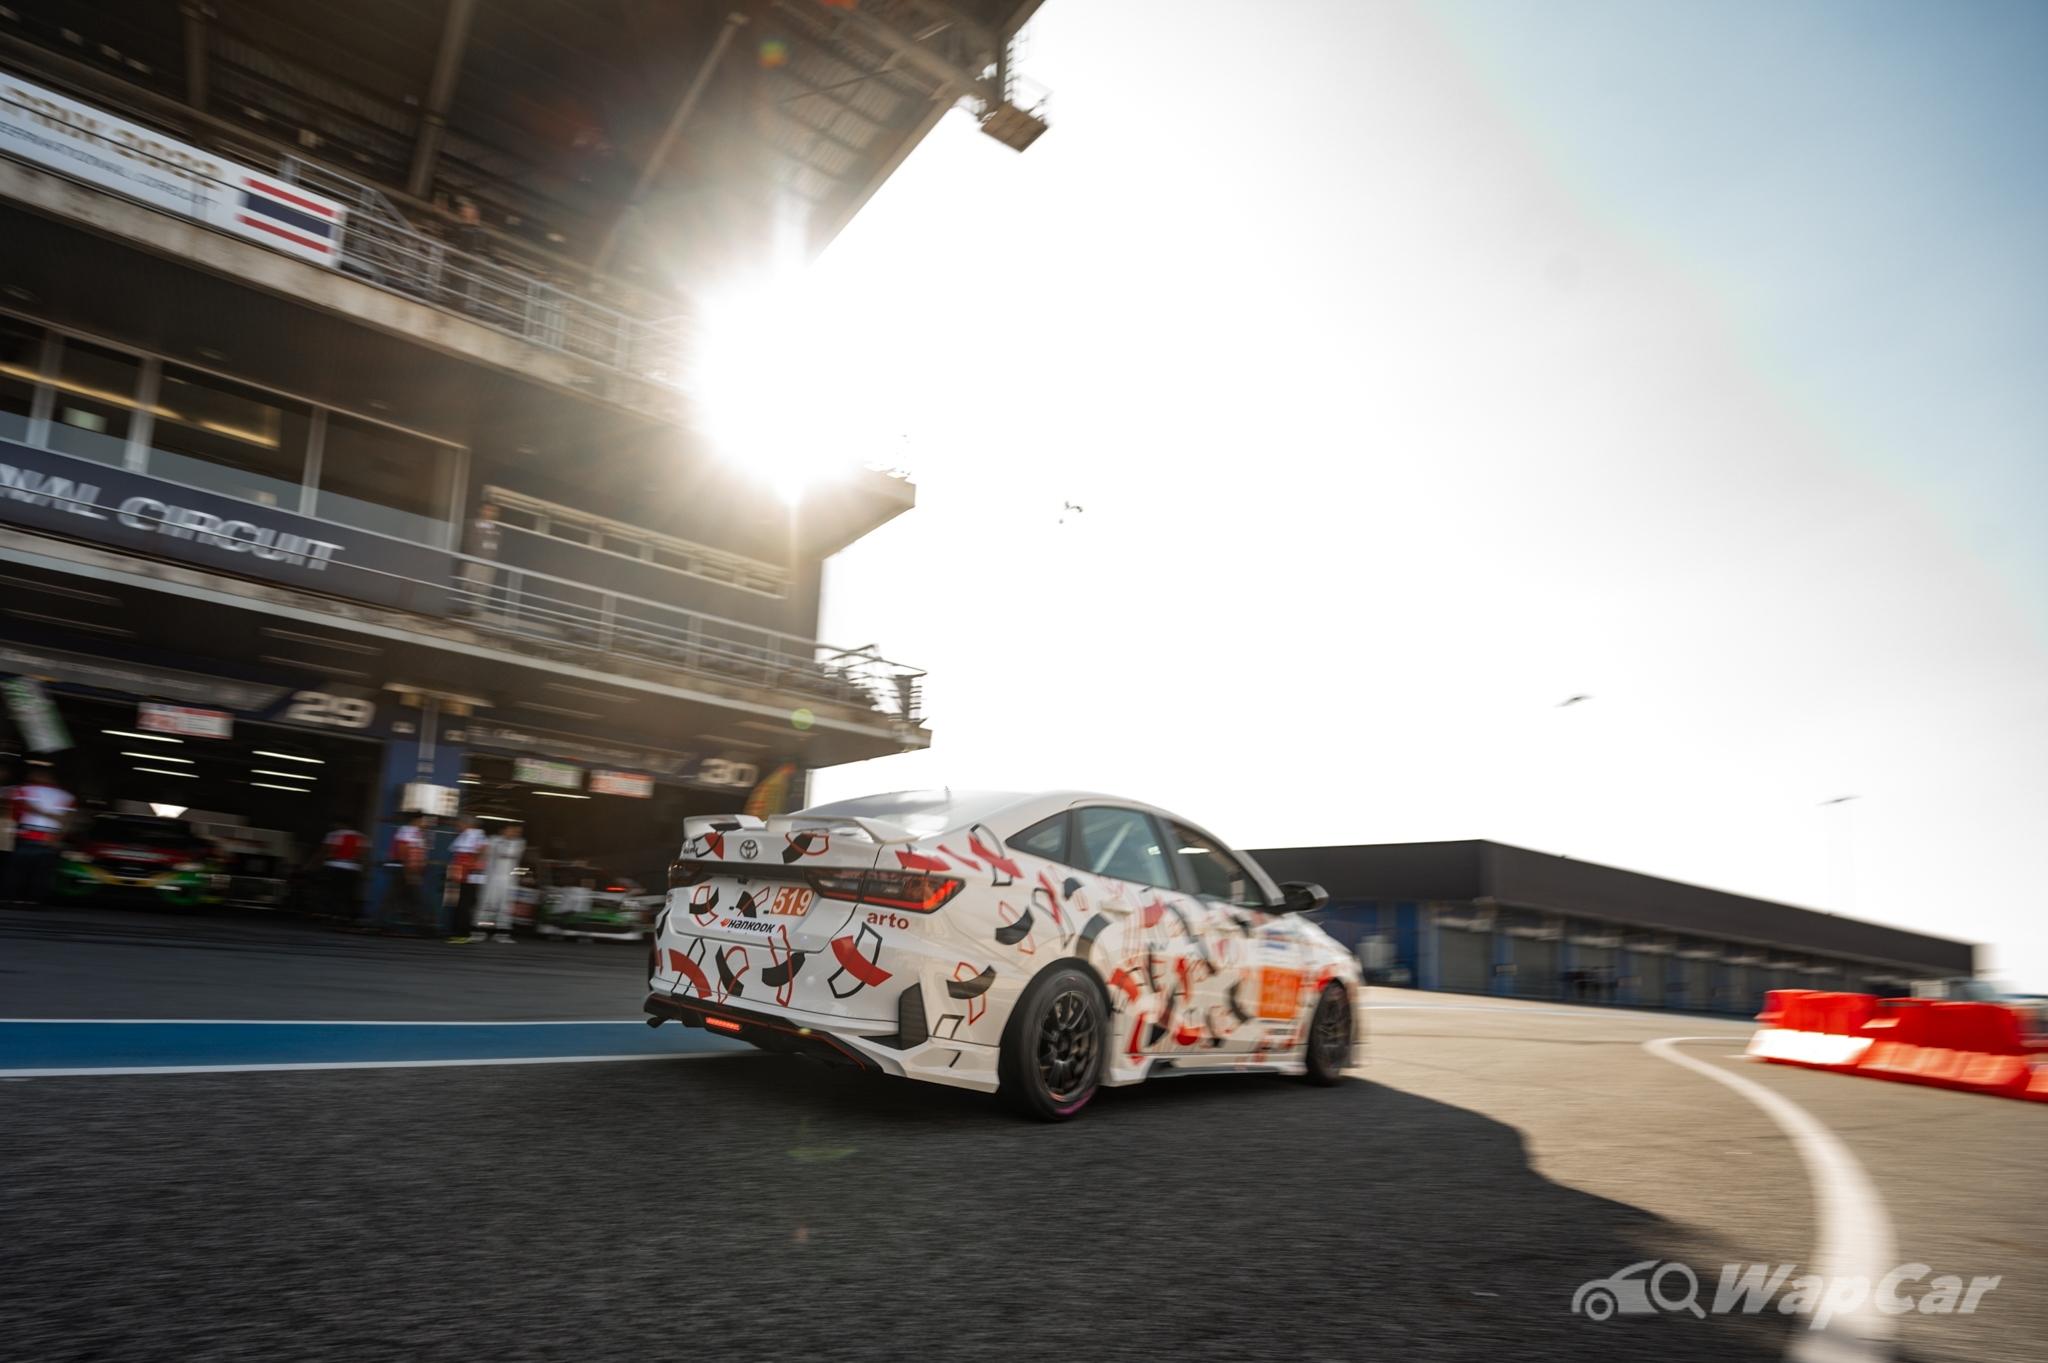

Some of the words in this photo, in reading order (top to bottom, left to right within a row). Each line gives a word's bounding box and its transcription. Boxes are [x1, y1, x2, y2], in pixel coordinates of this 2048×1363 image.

[117, 496, 346, 571] CIRCUIT
[286, 690, 376, 729] 29
[699, 758, 759, 788] 30
[773, 887, 814, 915] 519
[867, 912, 909, 930] arto
